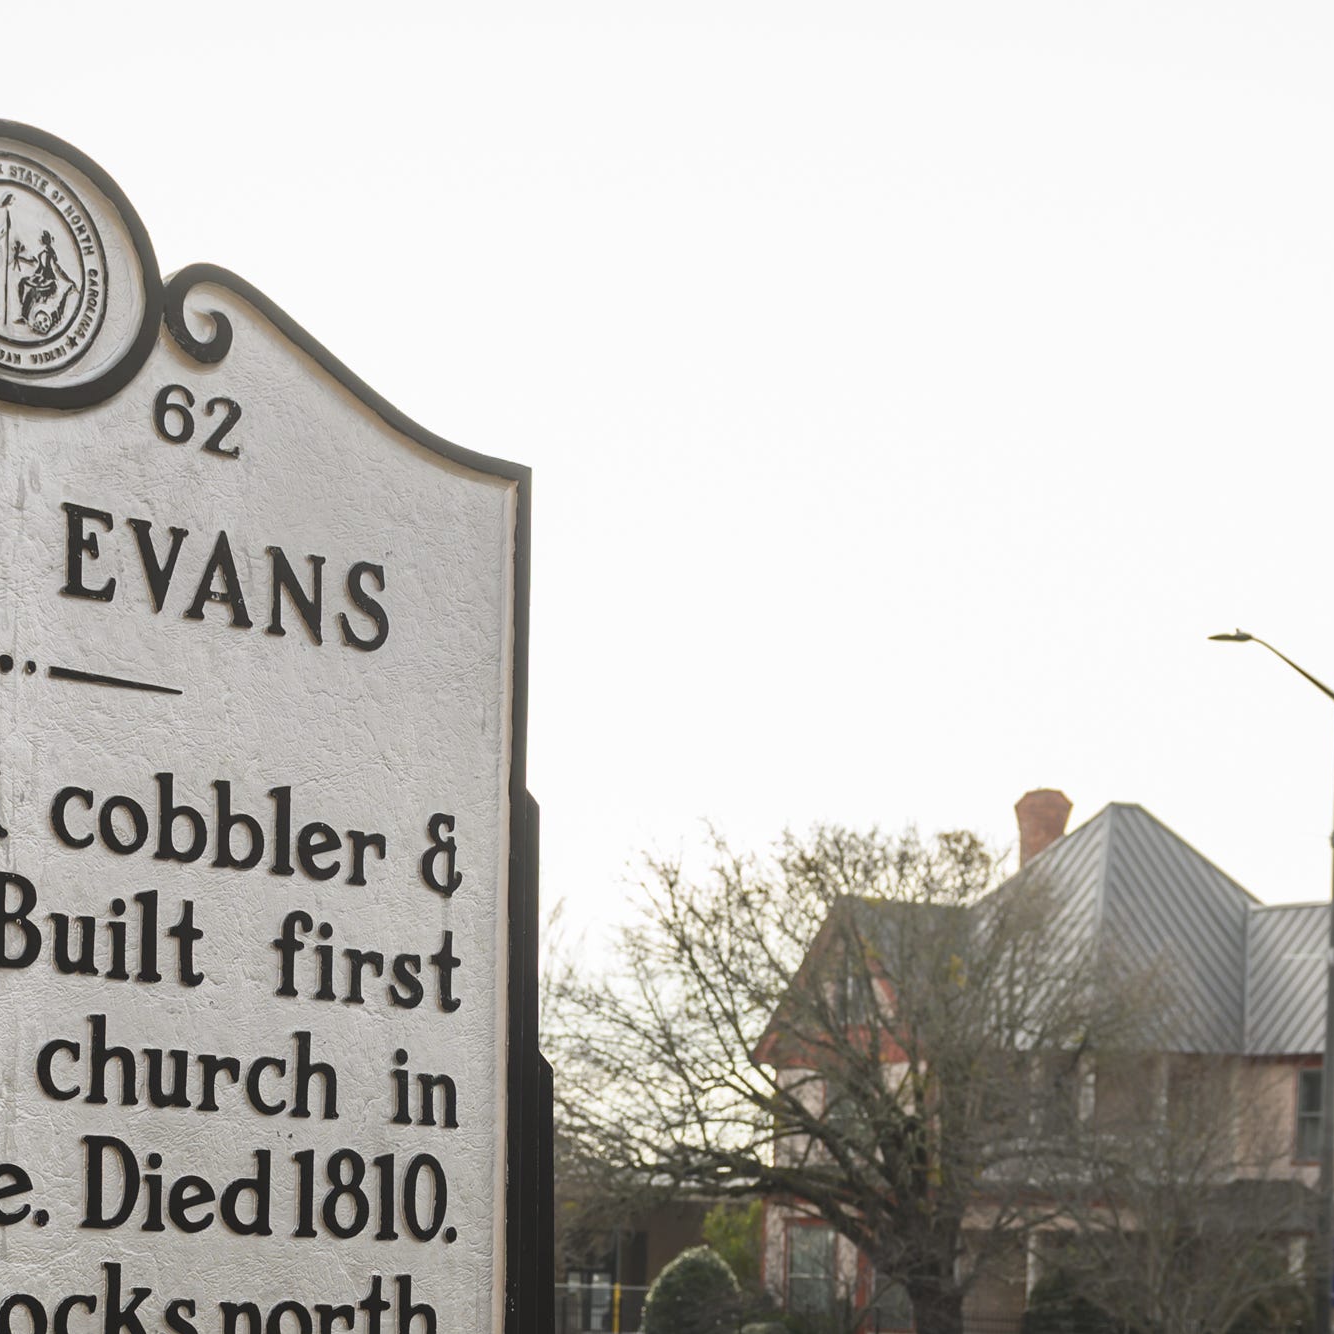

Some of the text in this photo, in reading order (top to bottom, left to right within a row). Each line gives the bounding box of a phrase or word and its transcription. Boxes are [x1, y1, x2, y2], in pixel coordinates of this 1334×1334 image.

[8, 165, 49, 195] STATE
[51, 189, 66, 206] OF
[63, 204, 95, 257] NORTH
[76, 268, 100, 338] CAROLINA
[154, 384, 242, 460] 62
[59, 502, 389, 652] EVANS
[50, 772, 387, 887] cobbler
[420, 812, 463, 899] &
[272, 910, 462, 1014] first
[36, 1013, 340, 1120] church
[390, 1048, 460, 1130] in
[79, 1134, 273, 1237] Died
[291, 1148, 458, 1244] 1810.
